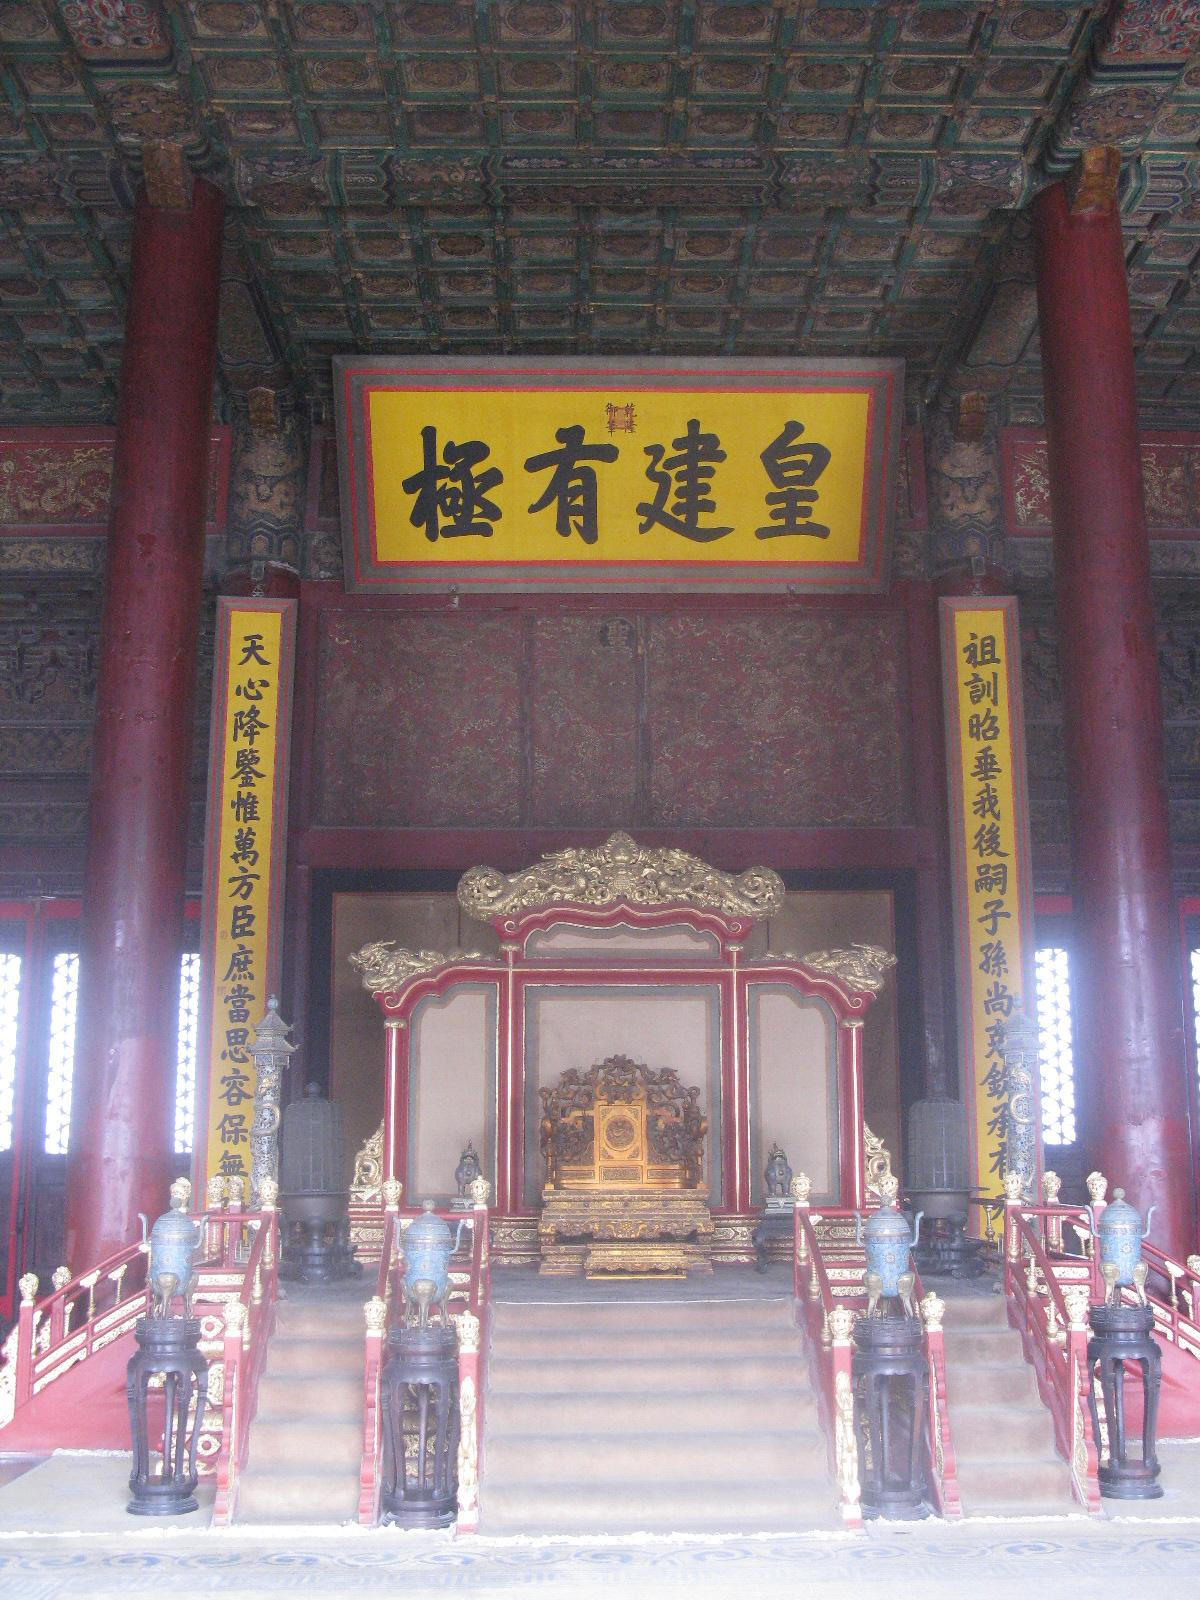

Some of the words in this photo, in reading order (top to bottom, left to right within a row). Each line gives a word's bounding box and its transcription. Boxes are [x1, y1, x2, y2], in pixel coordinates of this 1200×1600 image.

[402, 419, 832, 544] 皇建有極
[216, 633, 271, 1211] 天心降鑒惟萬方臣庶當思容保無
